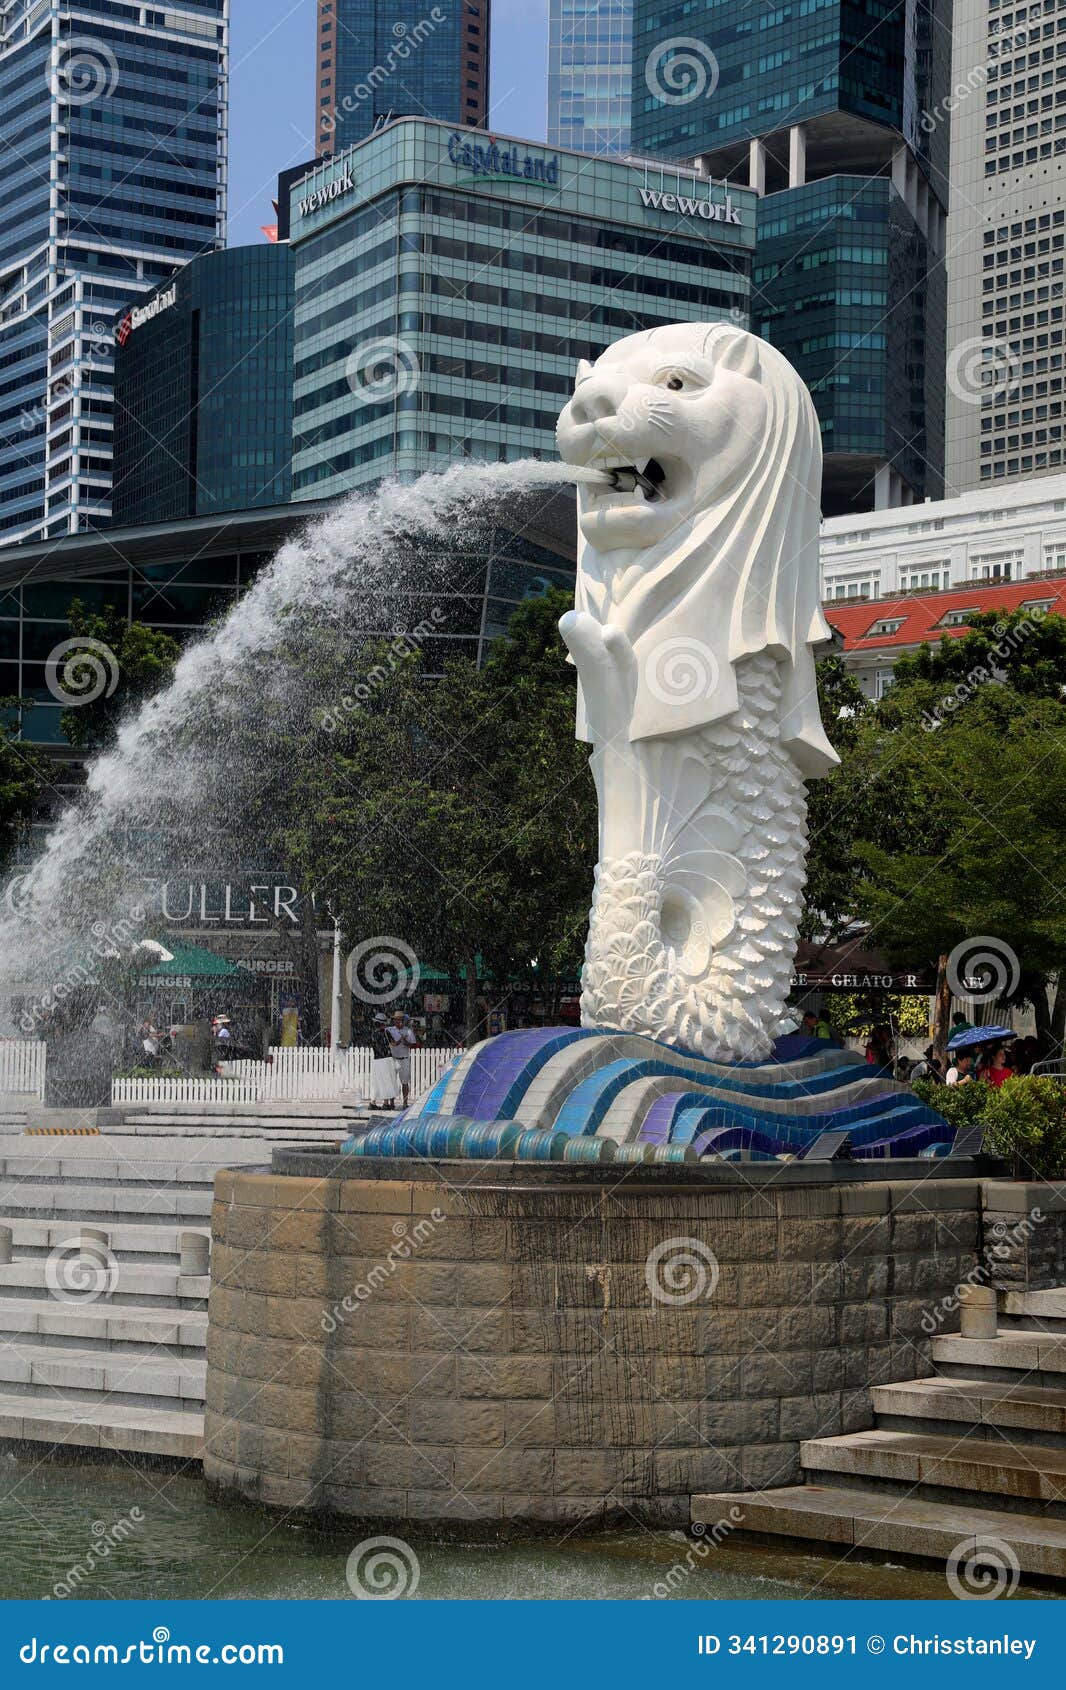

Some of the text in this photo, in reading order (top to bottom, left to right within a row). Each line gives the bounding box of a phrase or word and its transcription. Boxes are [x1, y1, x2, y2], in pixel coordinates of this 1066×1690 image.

[448, 134, 558, 184] CapitaLand
[298, 161, 354, 217] wework
[638, 188, 742, 225] wework
[138, 976, 192, 988] BURGER
[832, 974, 892, 988] GELATO
